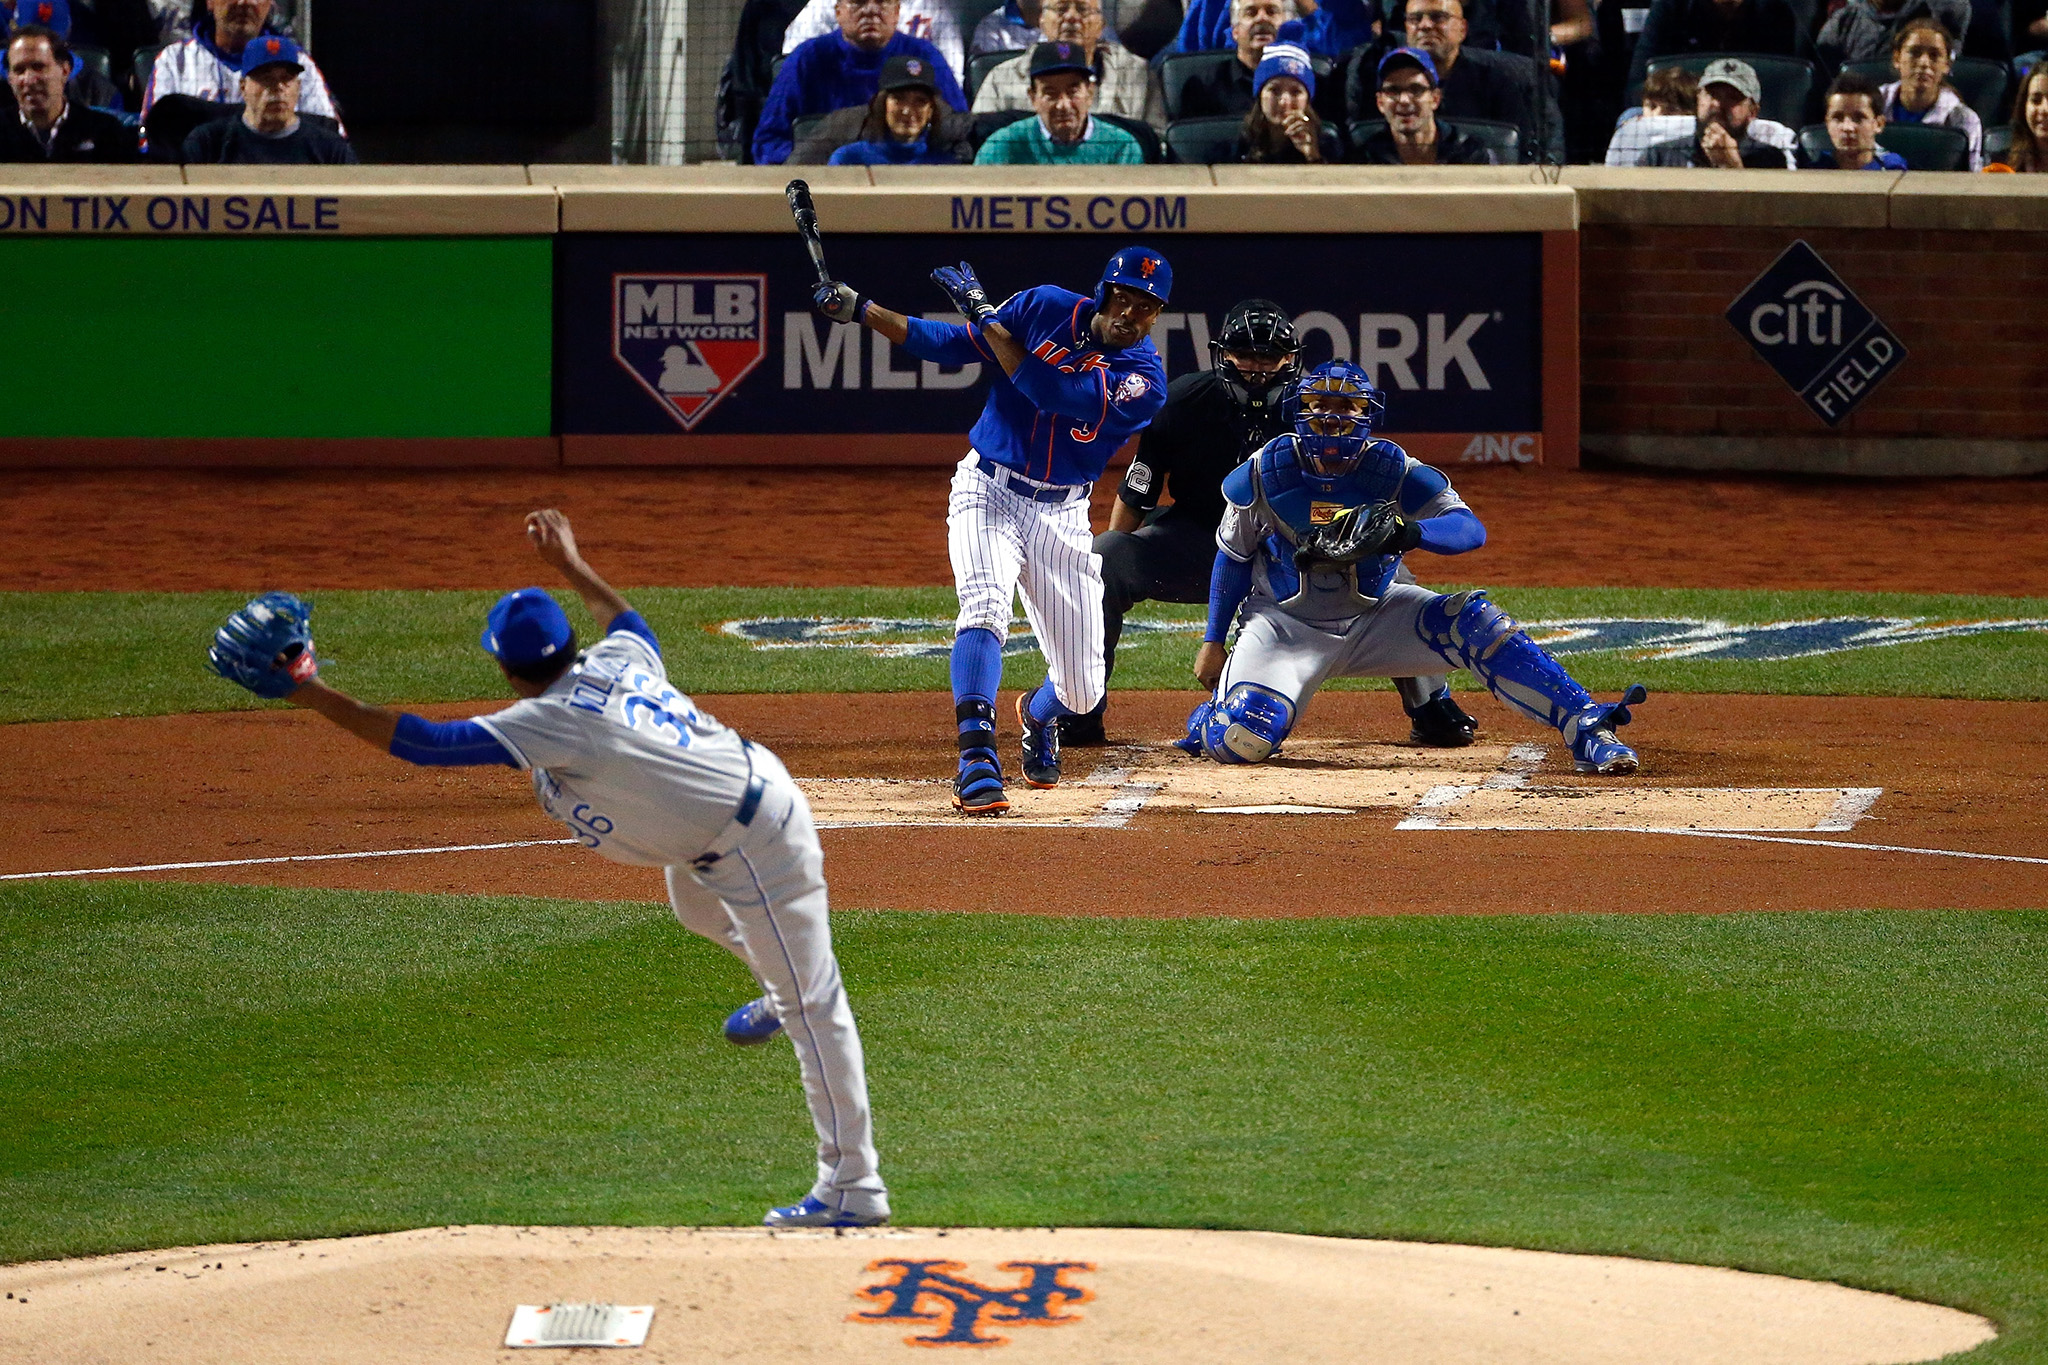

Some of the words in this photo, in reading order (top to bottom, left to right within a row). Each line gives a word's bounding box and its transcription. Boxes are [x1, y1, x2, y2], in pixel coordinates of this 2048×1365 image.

[62, 196, 130, 230] TIX
[147, 196, 210, 230] ON
[223, 196, 340, 230] SALE
[950, 195, 1188, 231] METS.COM
[623, 284, 757, 326] MLB
[623, 326, 757, 340] NETWORK
[1814, 336, 1894, 418] FIELD
[1460, 435, 1535, 463] ANC
